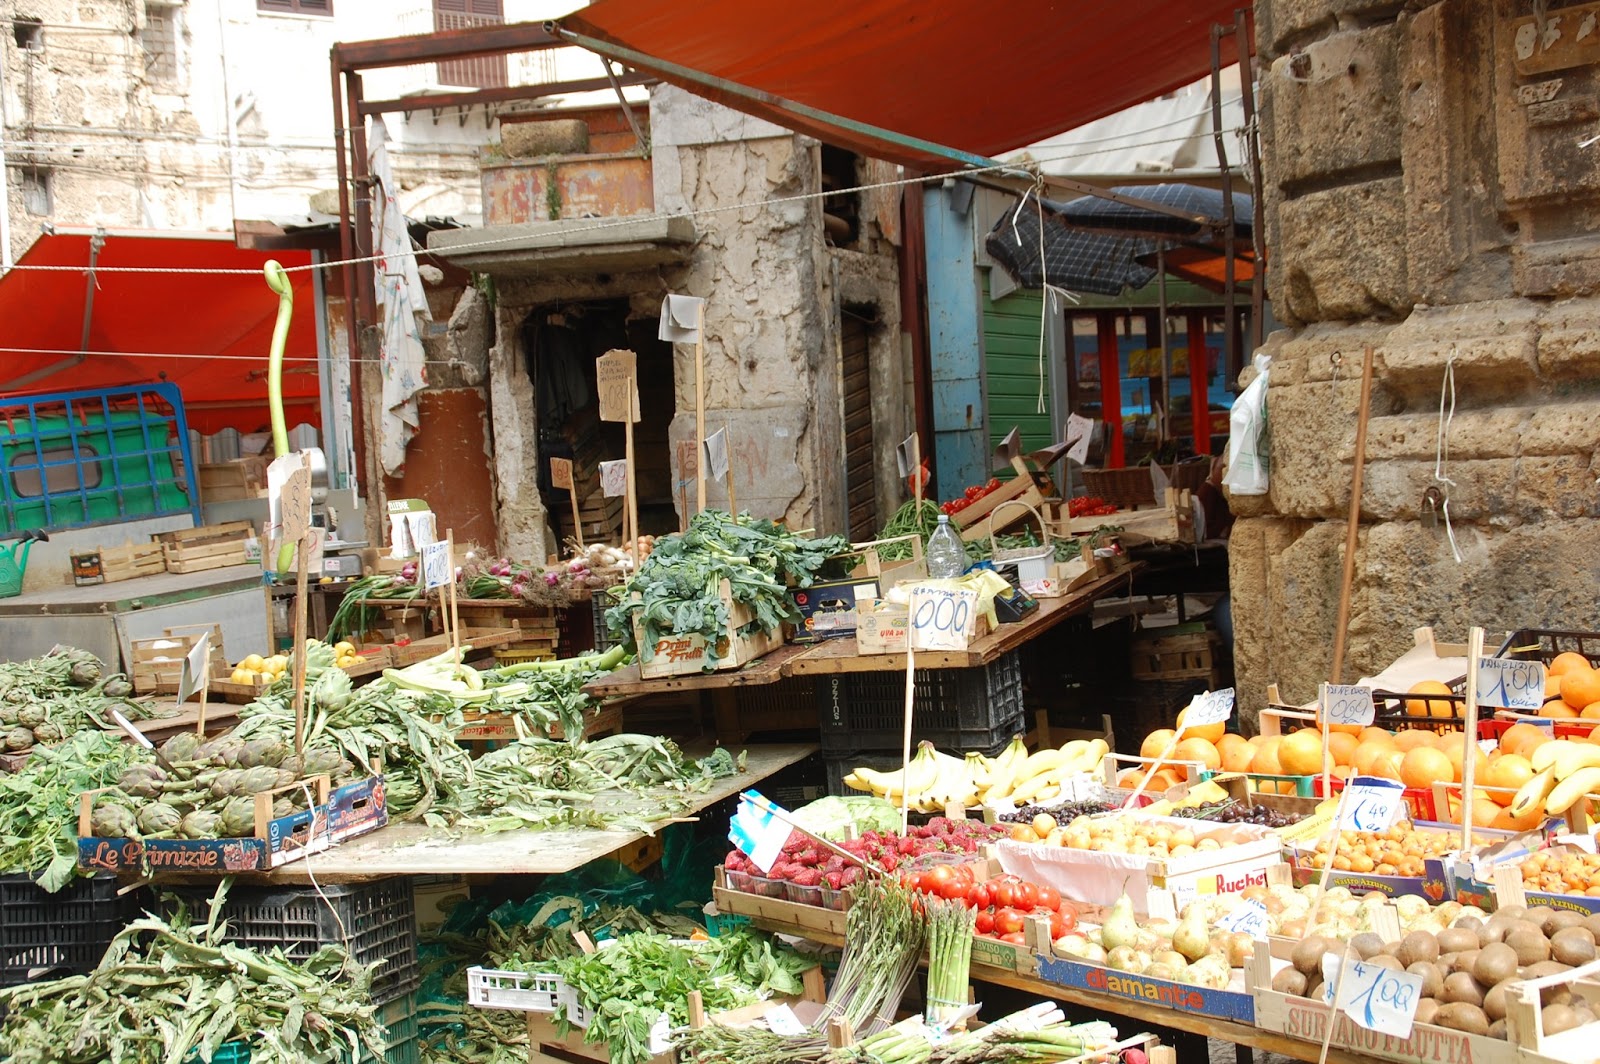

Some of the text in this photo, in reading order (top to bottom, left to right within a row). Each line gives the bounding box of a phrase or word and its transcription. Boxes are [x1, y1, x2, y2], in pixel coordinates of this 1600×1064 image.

[655, 636, 692, 657] Primi
[666, 646, 703, 664] Frutti
[89, 841, 119, 869] Le
[1333, 876, 1359, 887] Nastro
[1360, 877, 1394, 893] Azzurro
[1527, 896, 1592, 918] stro Azzurro
[972, 939, 1000, 955] REVISO
[1085, 967, 1205, 1010] diamante
